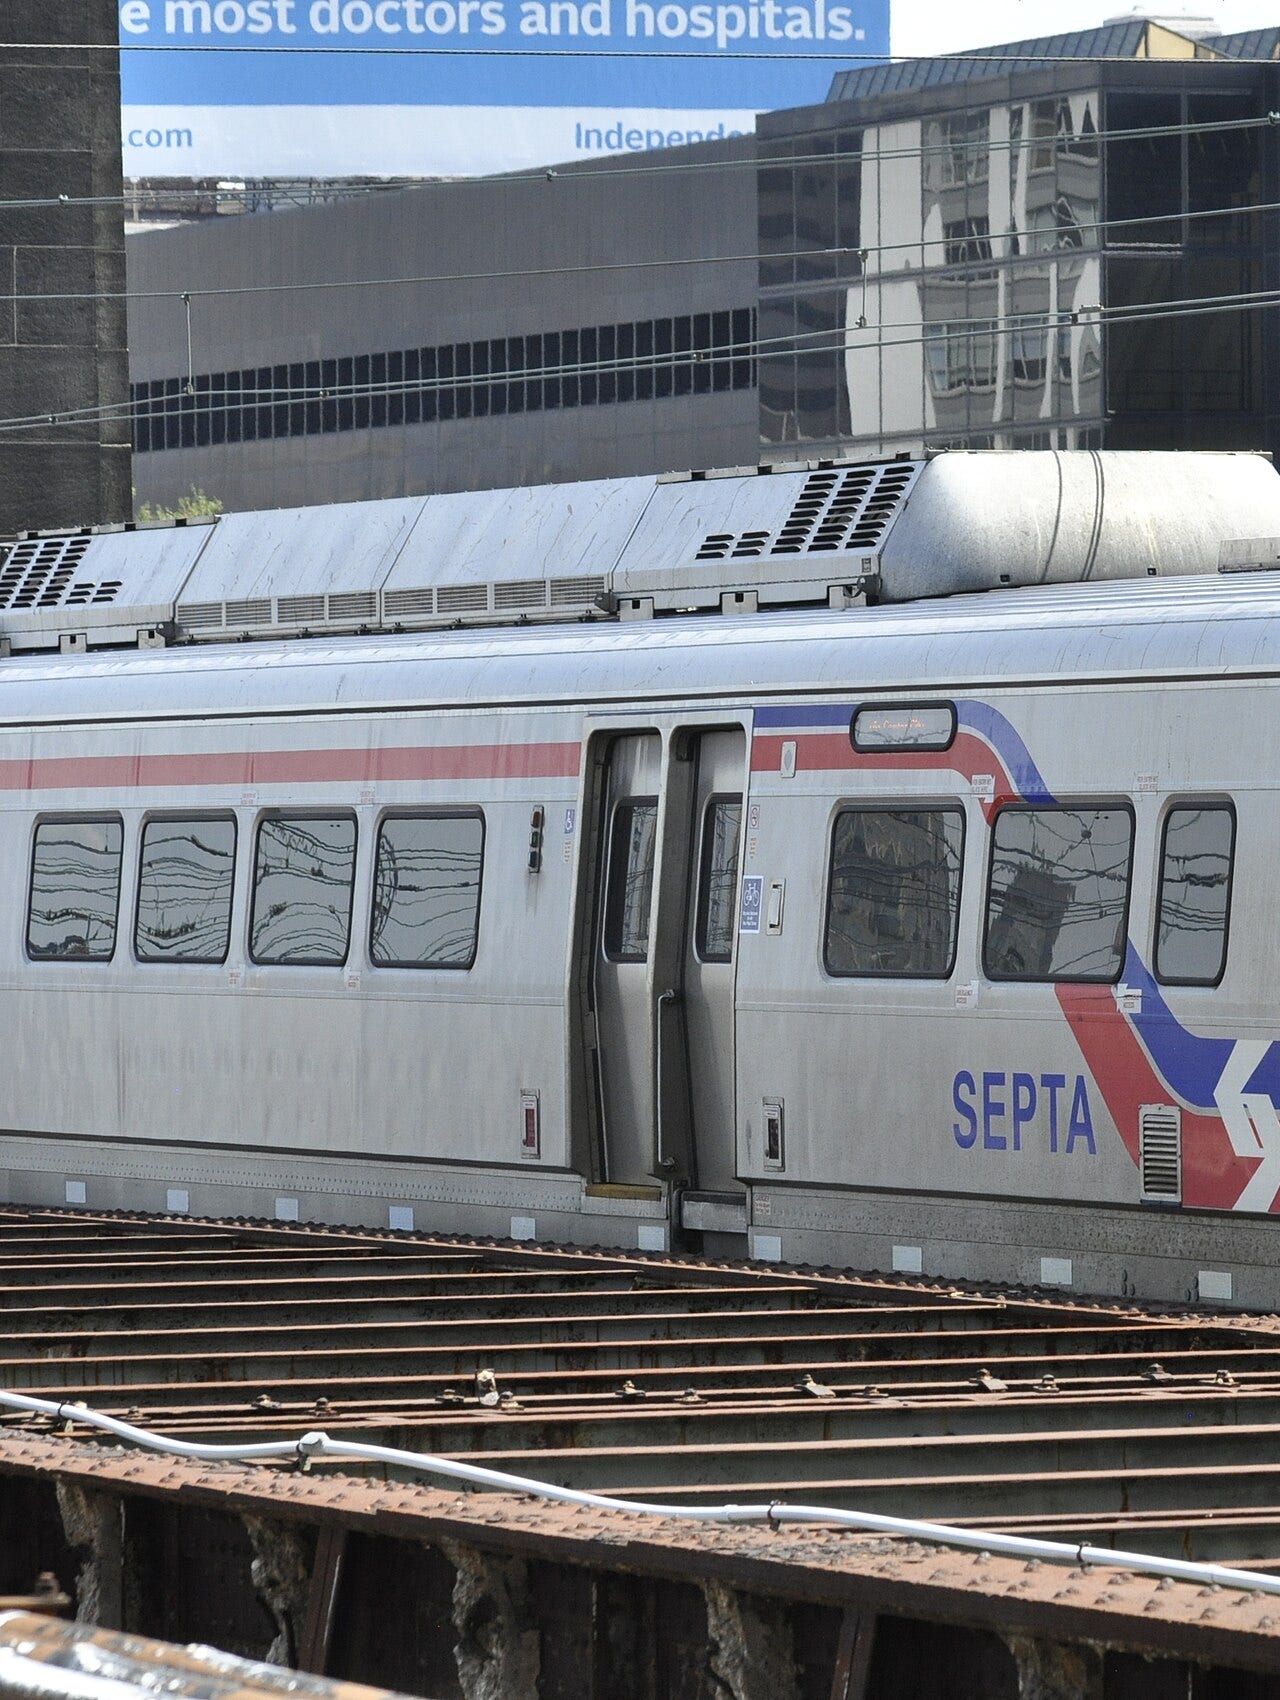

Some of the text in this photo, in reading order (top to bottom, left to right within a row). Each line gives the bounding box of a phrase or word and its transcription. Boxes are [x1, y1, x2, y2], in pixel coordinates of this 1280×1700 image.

[165, 0, 297, 34] most
[309, 0, 506, 35] doctors
[520, 0, 611, 36] and
[626, 0, 866, 49] hospitals.
[953, 1070, 1097, 1155] SEPTA
